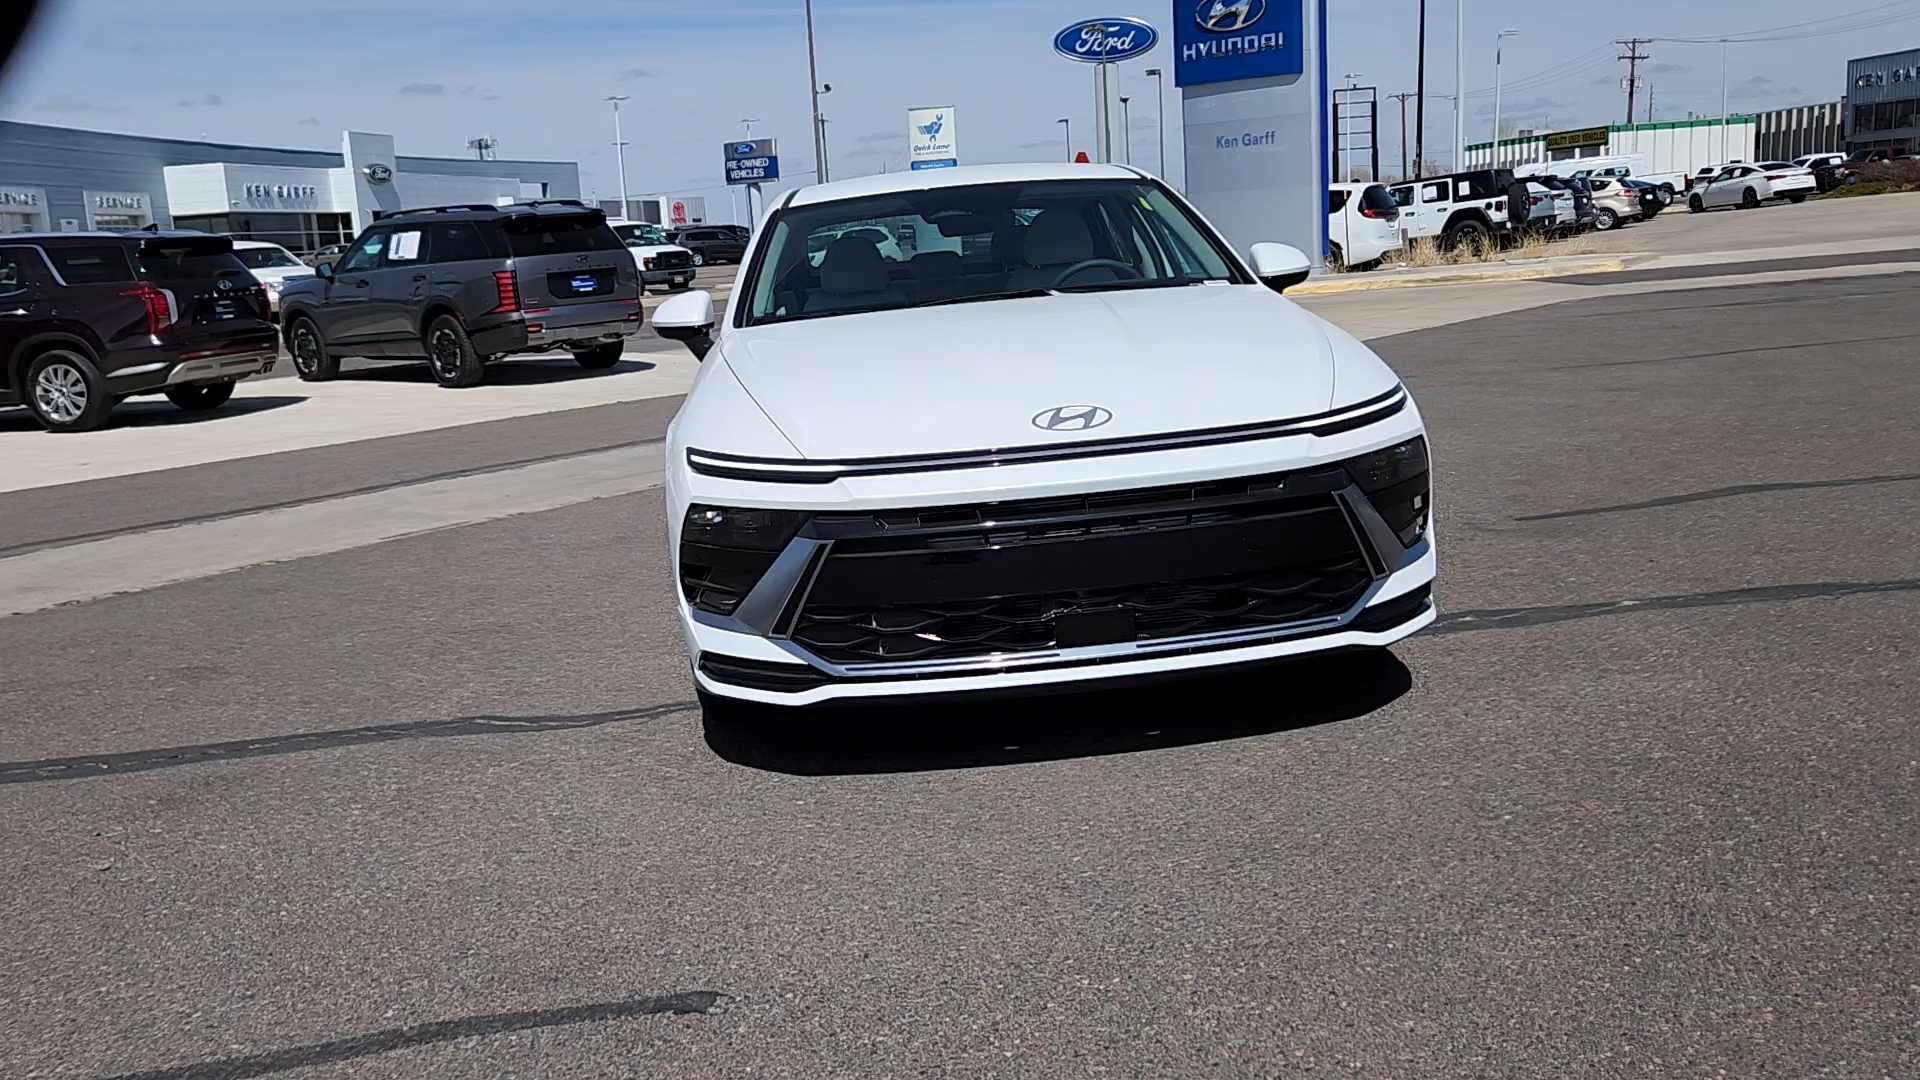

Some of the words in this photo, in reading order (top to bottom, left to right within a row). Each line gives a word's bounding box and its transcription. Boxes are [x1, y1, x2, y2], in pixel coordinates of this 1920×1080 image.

[1075, 25, 1134, 53] Ford
[1182, 31, 1284, 62] HYUNDAI
[913, 144, 931, 152] Quick
[932, 143, 951, 151] Lane
[1216, 135, 1238, 149] Ken
[1241, 131, 1276, 147] Garff
[726, 157, 770, 170] PRE-OWNED
[730, 168, 765, 179] VEHICLES
[244, 182, 272, 199] KEN
[95, 195, 143, 209] SERVICE
